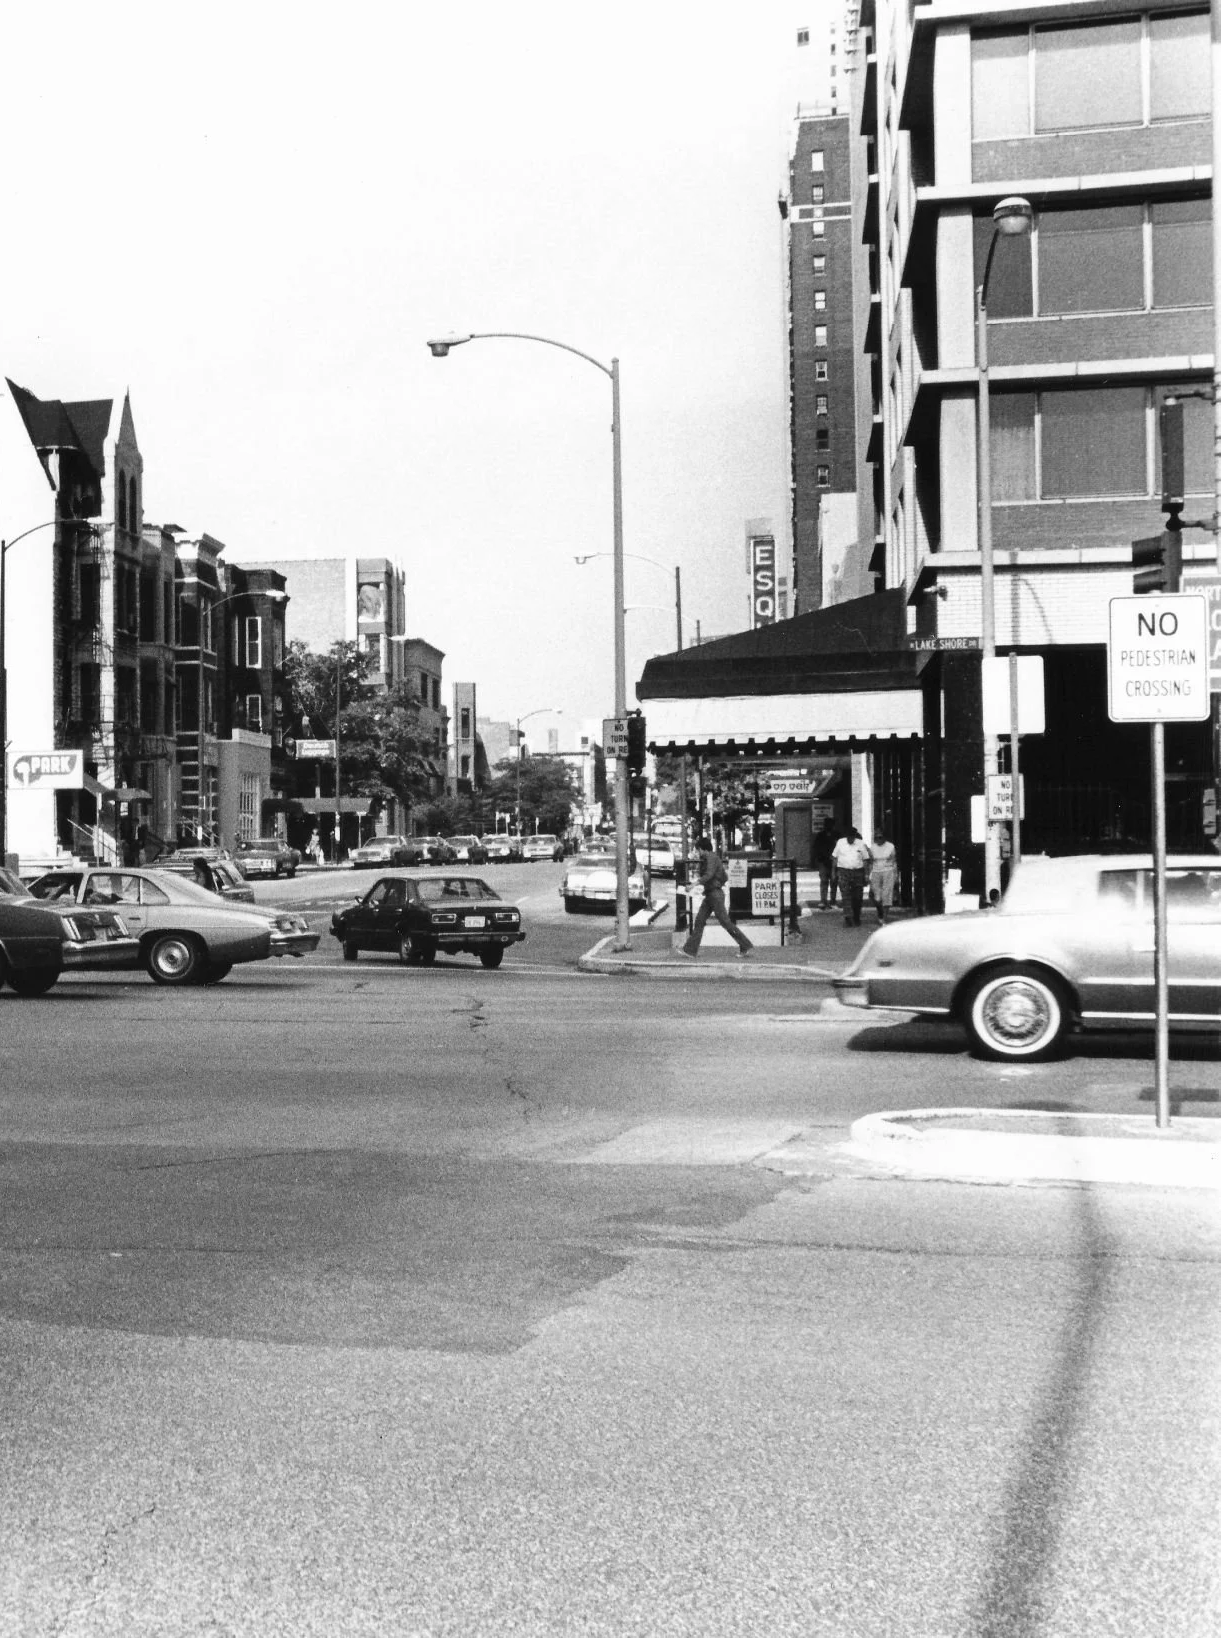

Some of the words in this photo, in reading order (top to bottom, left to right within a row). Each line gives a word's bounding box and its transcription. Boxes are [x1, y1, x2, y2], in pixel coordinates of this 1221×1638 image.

[755, 546, 773, 626] ESQ
[1138, 612, 1178, 636] NO
[915, 640, 936, 650] LAKE
[939, 639, 968, 649] SHORE
[1121, 649, 1196, 667] PEDESTRIAN
[1125, 680, 1191, 697] CROSSING
[619, 745, 628, 754] RE
[31, 756, 71, 773] PARK
[1001, 780, 1010, 789] NO
[993, 806, 1002, 815] ON
[755, 882, 777, 890] PARK
